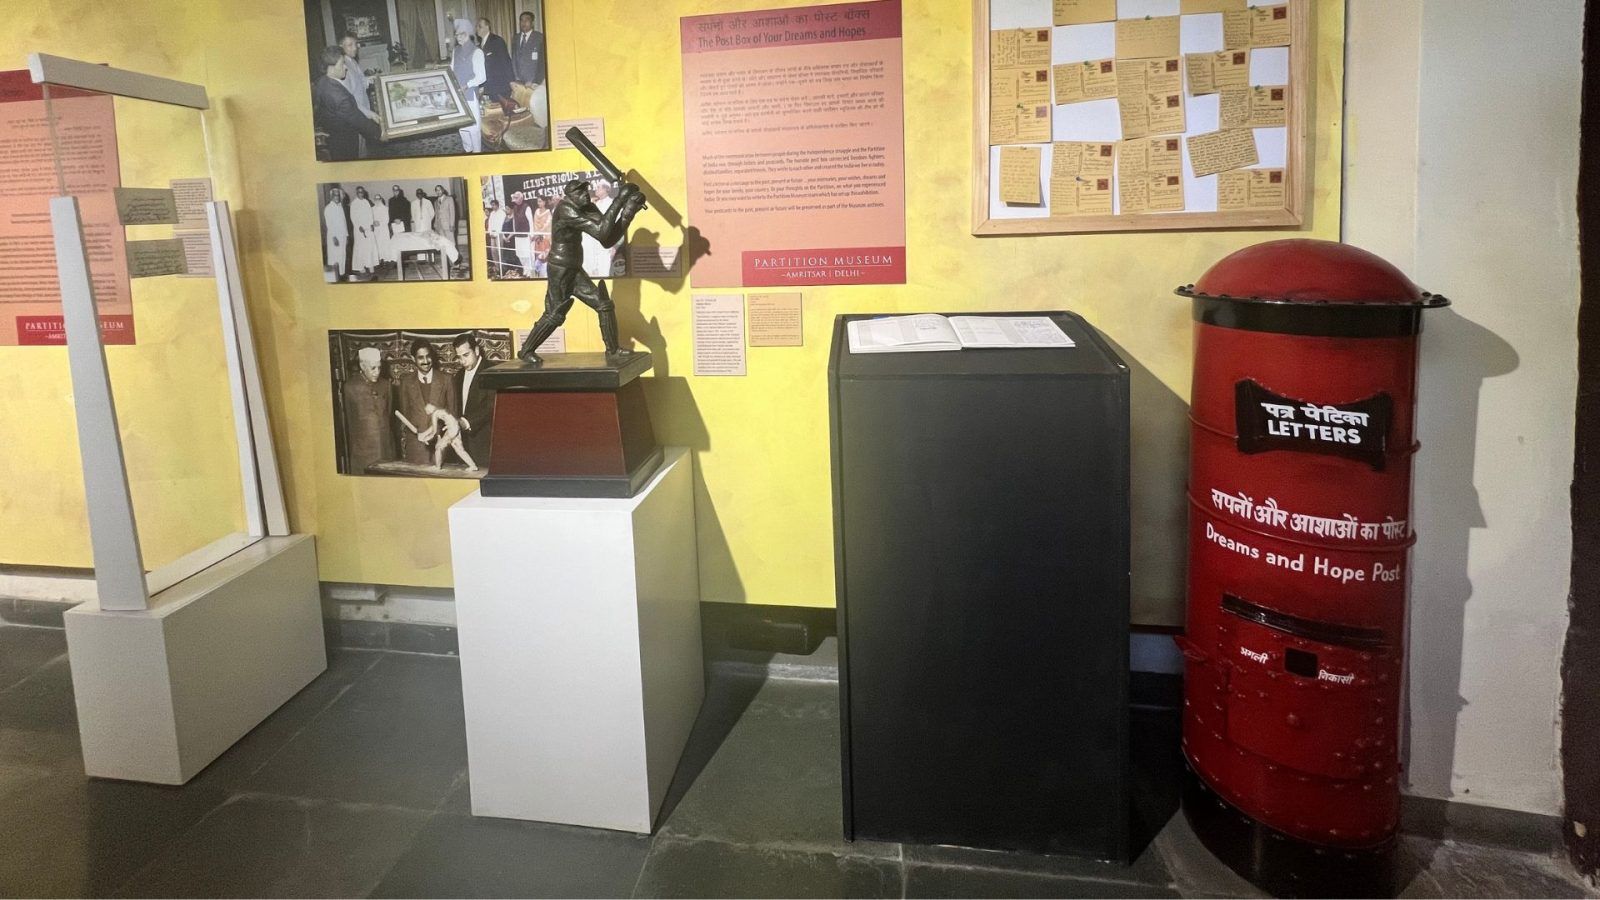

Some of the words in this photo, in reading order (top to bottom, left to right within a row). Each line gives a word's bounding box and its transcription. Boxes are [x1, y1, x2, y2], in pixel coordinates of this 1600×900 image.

[698, 37, 714, 48] The
[716, 35, 733, 46] Post
[736, 34, 752, 46] Box
[753, 32, 762, 44] of
[763, 31, 782, 43] Your
[785, 29, 818, 42] Dreams
[819, 27, 836, 39] and
[839, 26, 866, 39] Hopes
[523, 171, 579, 190] ILLUSTRIOUS
[754, 256, 828, 268] PARTITION
[834, 255, 892, 266] MUSEUM
[25, 321, 65, 331] PARTITI
[1260, 402, 1295, 420] पत्र
[1300, 402, 1370, 427] पेटिका
[1267, 419, 1361, 445] LETTERS
[1211, 488, 1253, 520] सपनों
[1253, 497, 1289, 530] और
[1290, 512, 1358, 541] आशाओं
[1360, 522, 1380, 541] का
[1206, 522, 1259, 558] Dreams
[1266, 553, 1304, 572] and
[1314, 556, 1365, 584] Hope
[1372, 562, 1400, 583] Post
